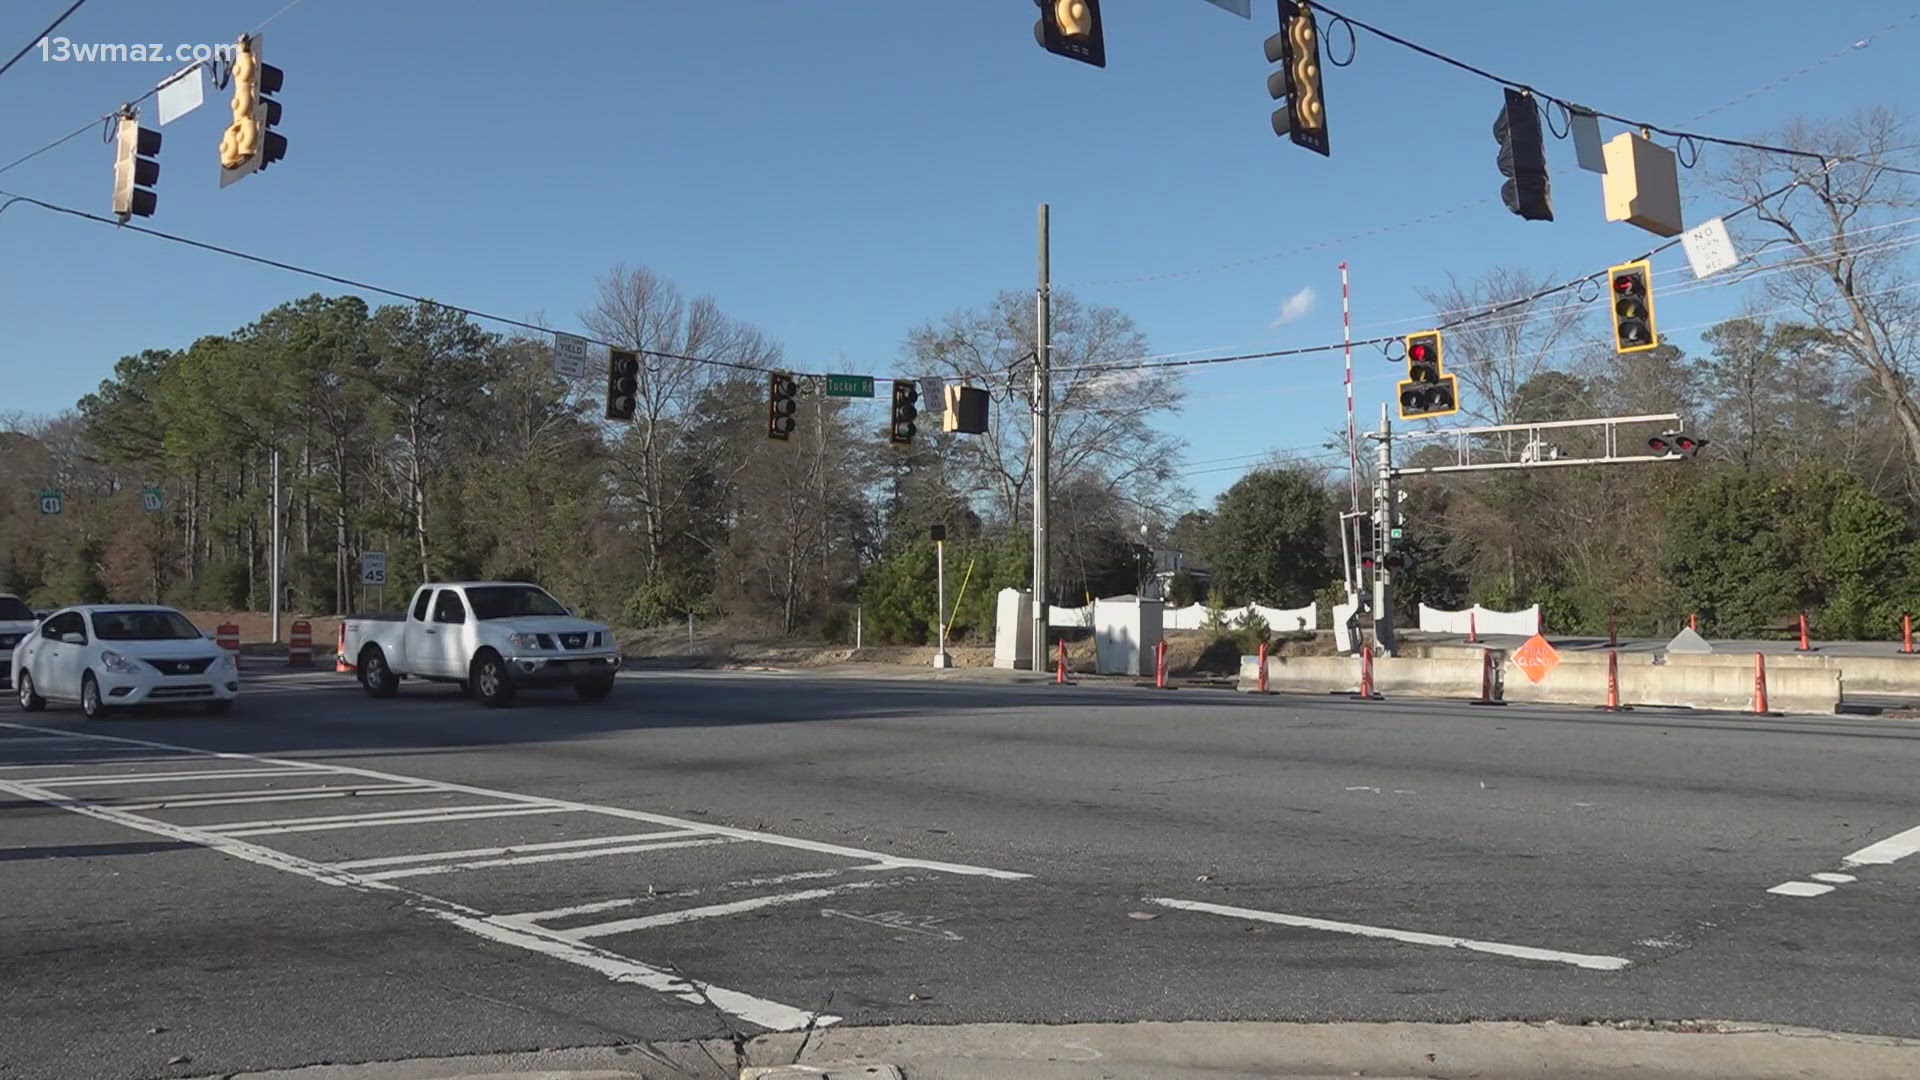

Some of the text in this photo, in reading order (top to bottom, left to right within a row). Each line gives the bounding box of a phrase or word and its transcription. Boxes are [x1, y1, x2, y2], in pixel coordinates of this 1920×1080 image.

[1694, 227, 1713, 241] NO
[559, 343, 583, 355] YIELD
[828, 379, 873, 393] Tucker Rd
[44, 499, 57, 511] 41
[365, 570, 385, 582] 45
